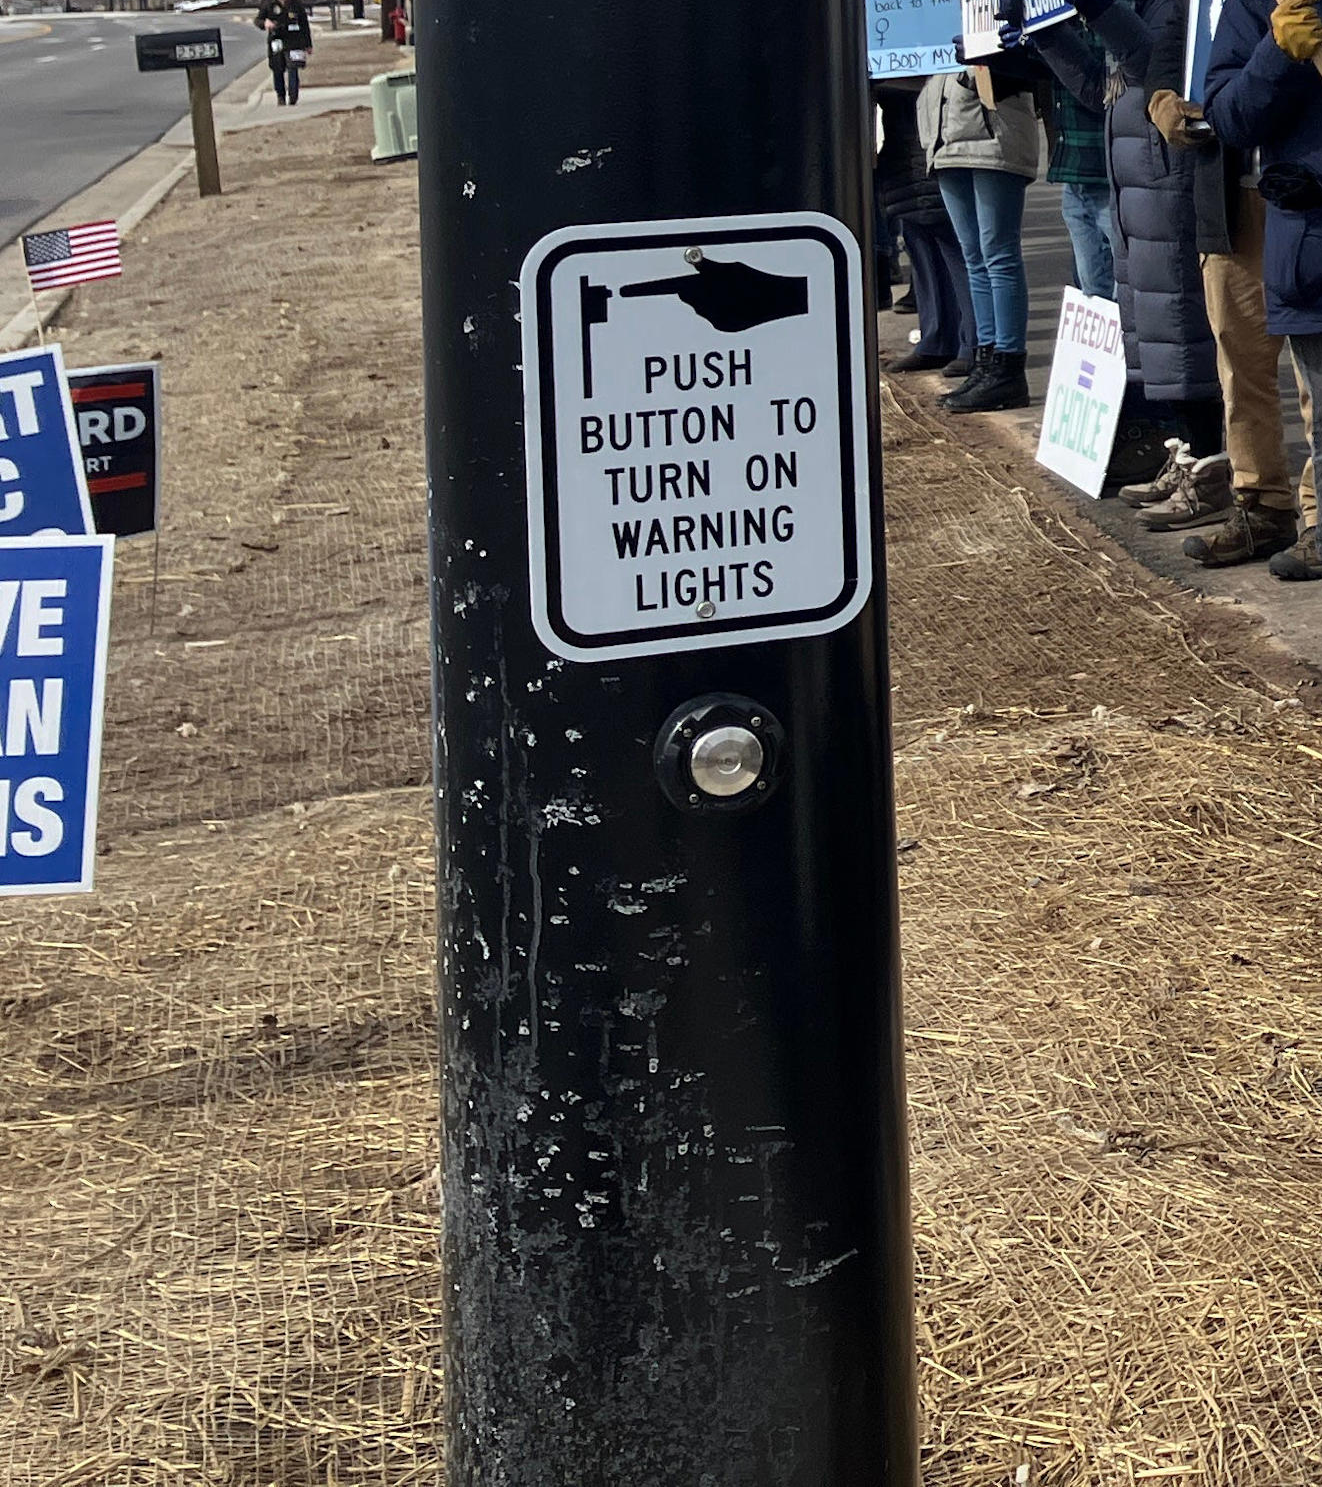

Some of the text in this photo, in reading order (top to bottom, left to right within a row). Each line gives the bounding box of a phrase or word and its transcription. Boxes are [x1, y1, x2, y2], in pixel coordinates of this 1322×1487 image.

[887, 52, 927, 71] BODY
[933, 49, 953, 65] MY
[644, 348, 753, 394] PUSH
[78, 406, 147, 447] RD
[580, 396, 817, 454] BUTTON TO
[1049, 384, 1110, 462] CHOICE
[86, 456, 112, 473] RT
[605, 451, 798, 506] TURN ON
[612, 505, 794, 559] WARNING
[636, 560, 774, 611] LIGHTS
